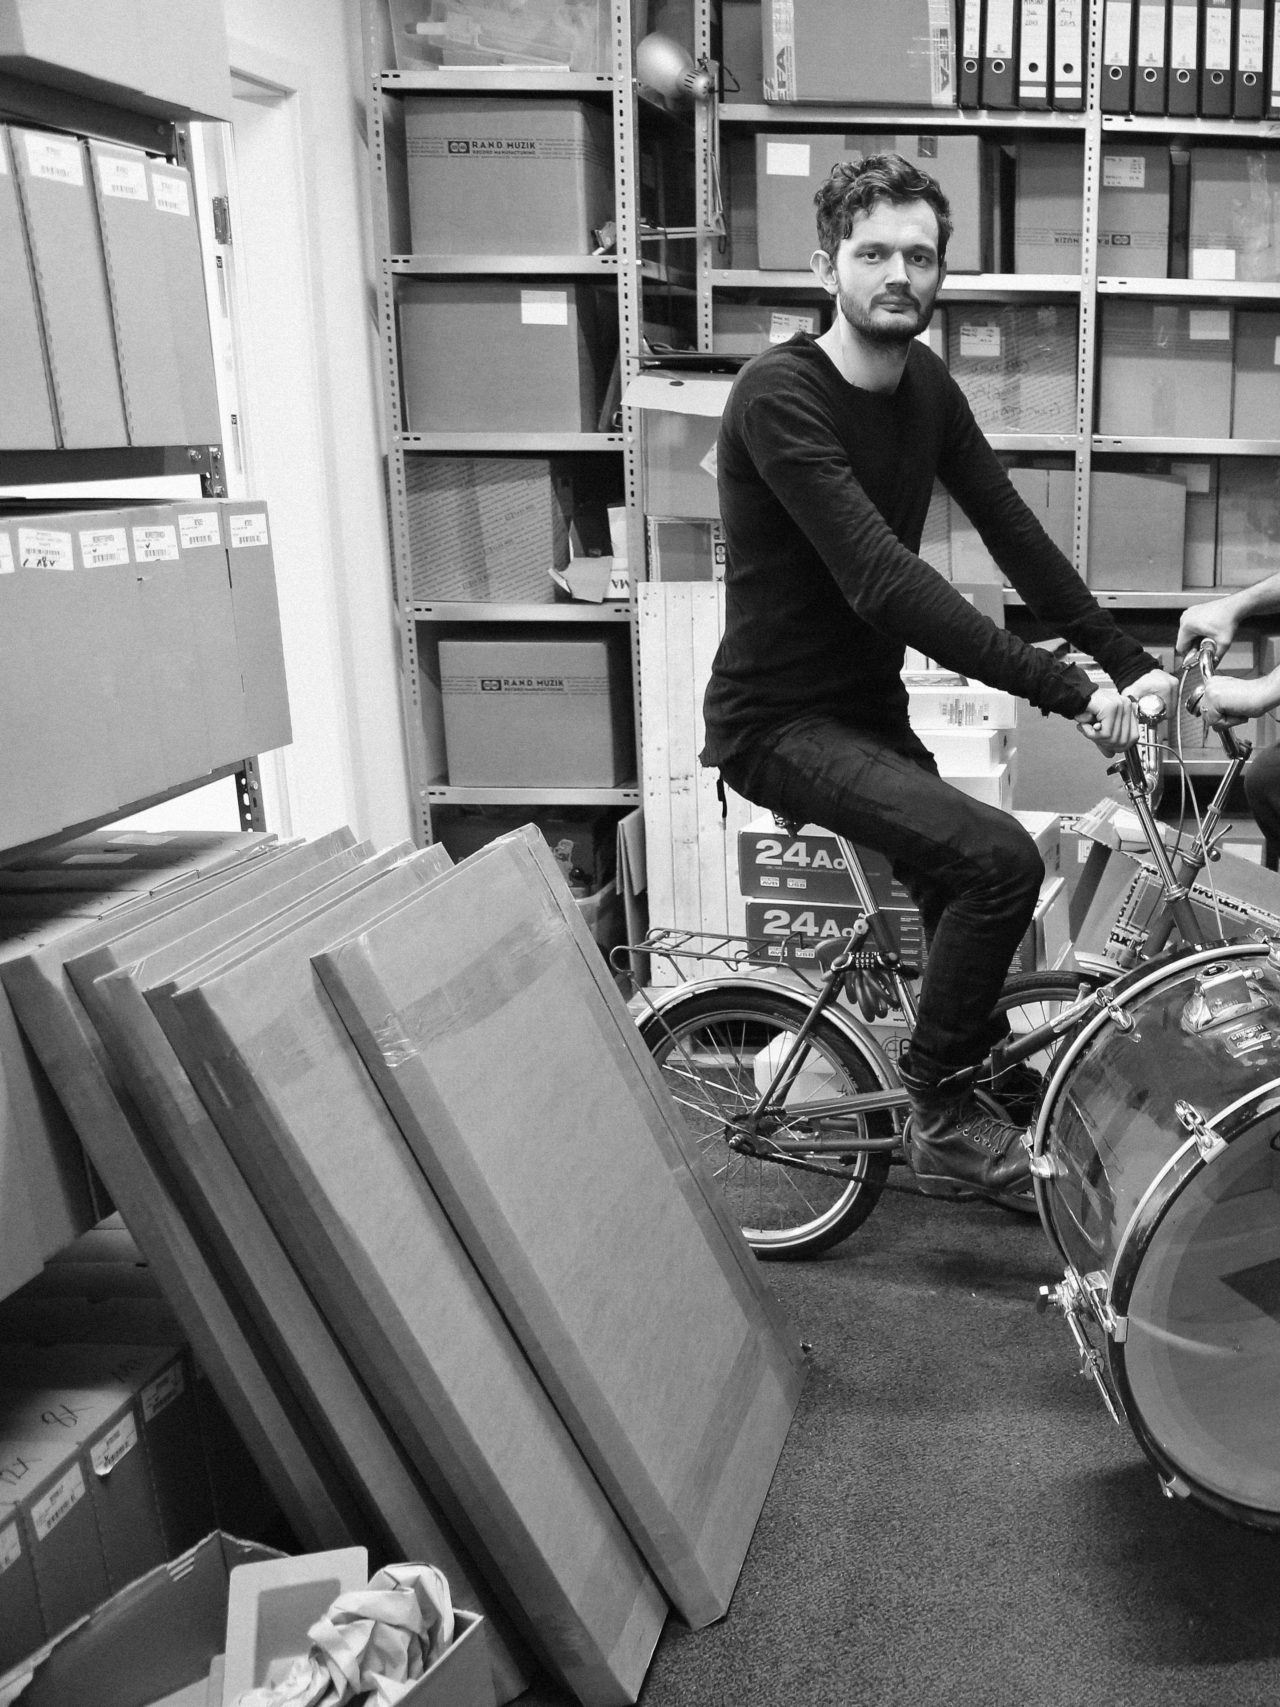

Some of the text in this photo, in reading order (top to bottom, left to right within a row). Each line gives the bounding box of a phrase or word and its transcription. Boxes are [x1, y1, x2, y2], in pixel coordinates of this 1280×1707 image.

[506, 141, 536, 150] MUZIK
[536, 679, 564, 687] MUZIK
[755, 839, 848, 870] 24Ao
